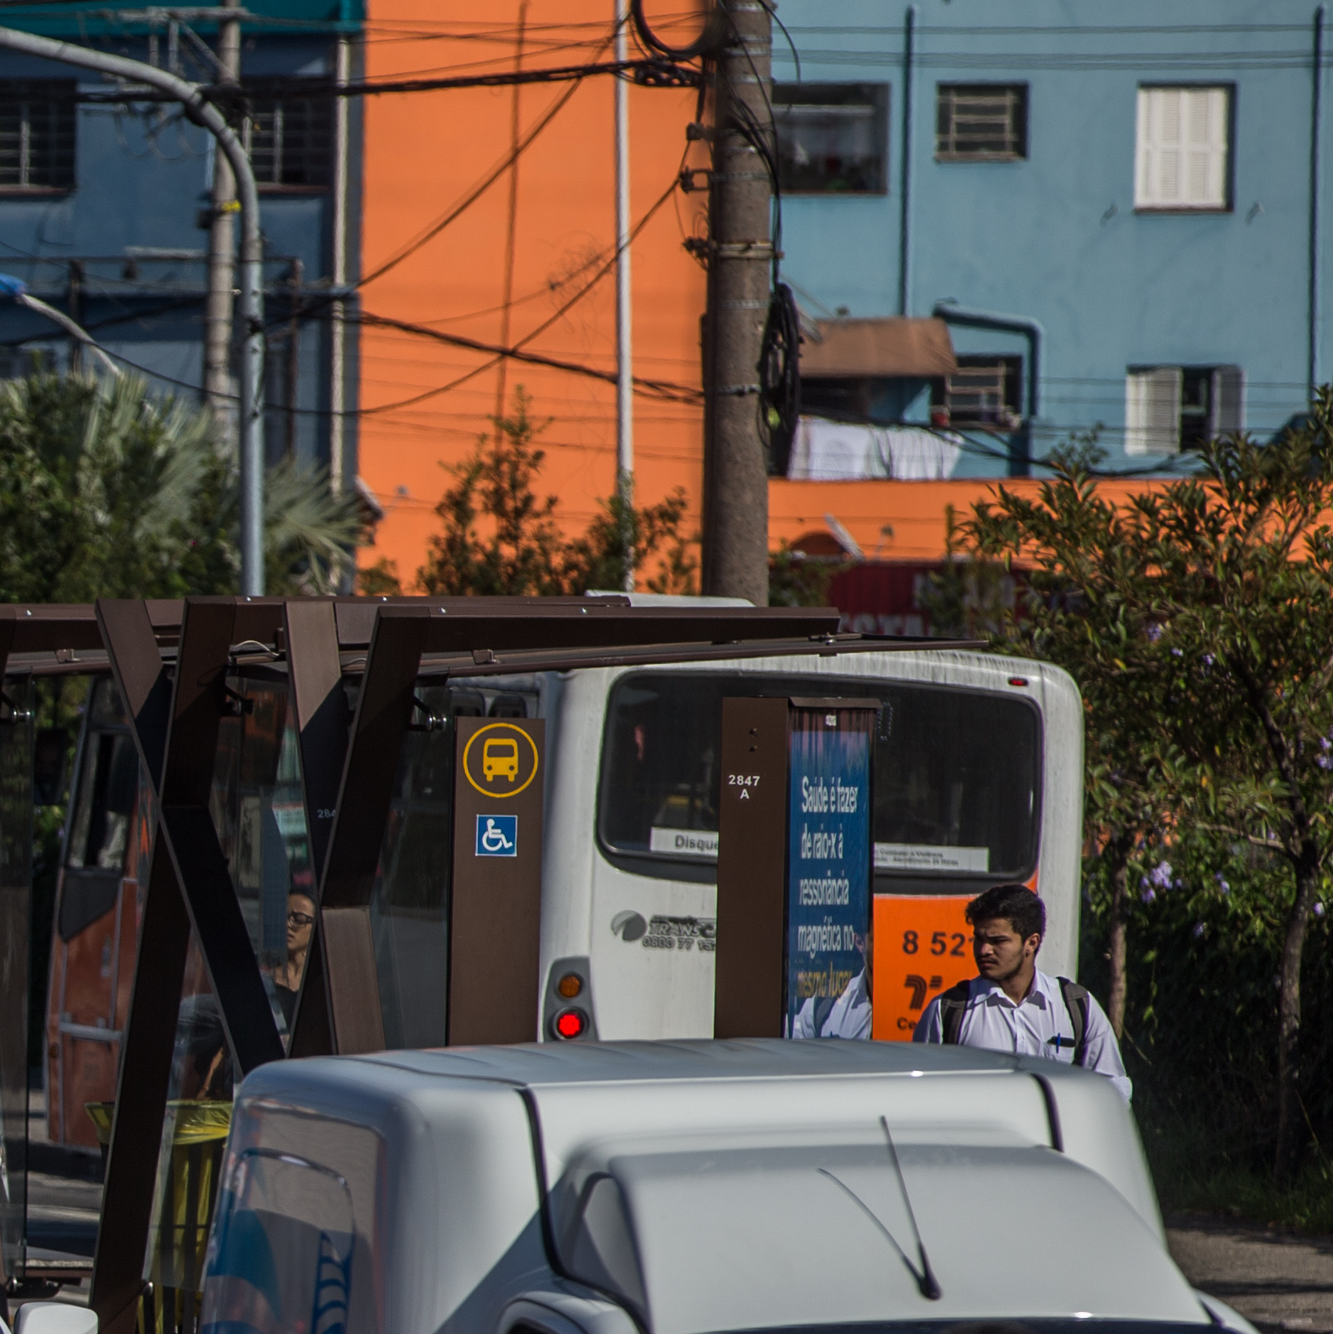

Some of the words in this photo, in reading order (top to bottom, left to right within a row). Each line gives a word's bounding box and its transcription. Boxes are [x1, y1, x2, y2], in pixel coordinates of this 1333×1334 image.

[728, 775, 760, 787] 2847
[740, 789, 750, 799] A
[802, 776, 828, 813] Saúde
[830, 777, 836, 813] é
[837, 777, 858, 813] fazer
[801, 823, 811, 859] de
[813, 823, 837, 859] raio-x
[838, 823, 844, 859] à
[799, 870, 849, 905] ressonância
[798, 915, 841, 959] magnética
[844, 924, 854, 951] no
[903, 930, 919, 955] 8
[930, 931, 975, 957] 52
[797, 969, 826, 998] mesmo
[828, 961, 853, 999] lugar
